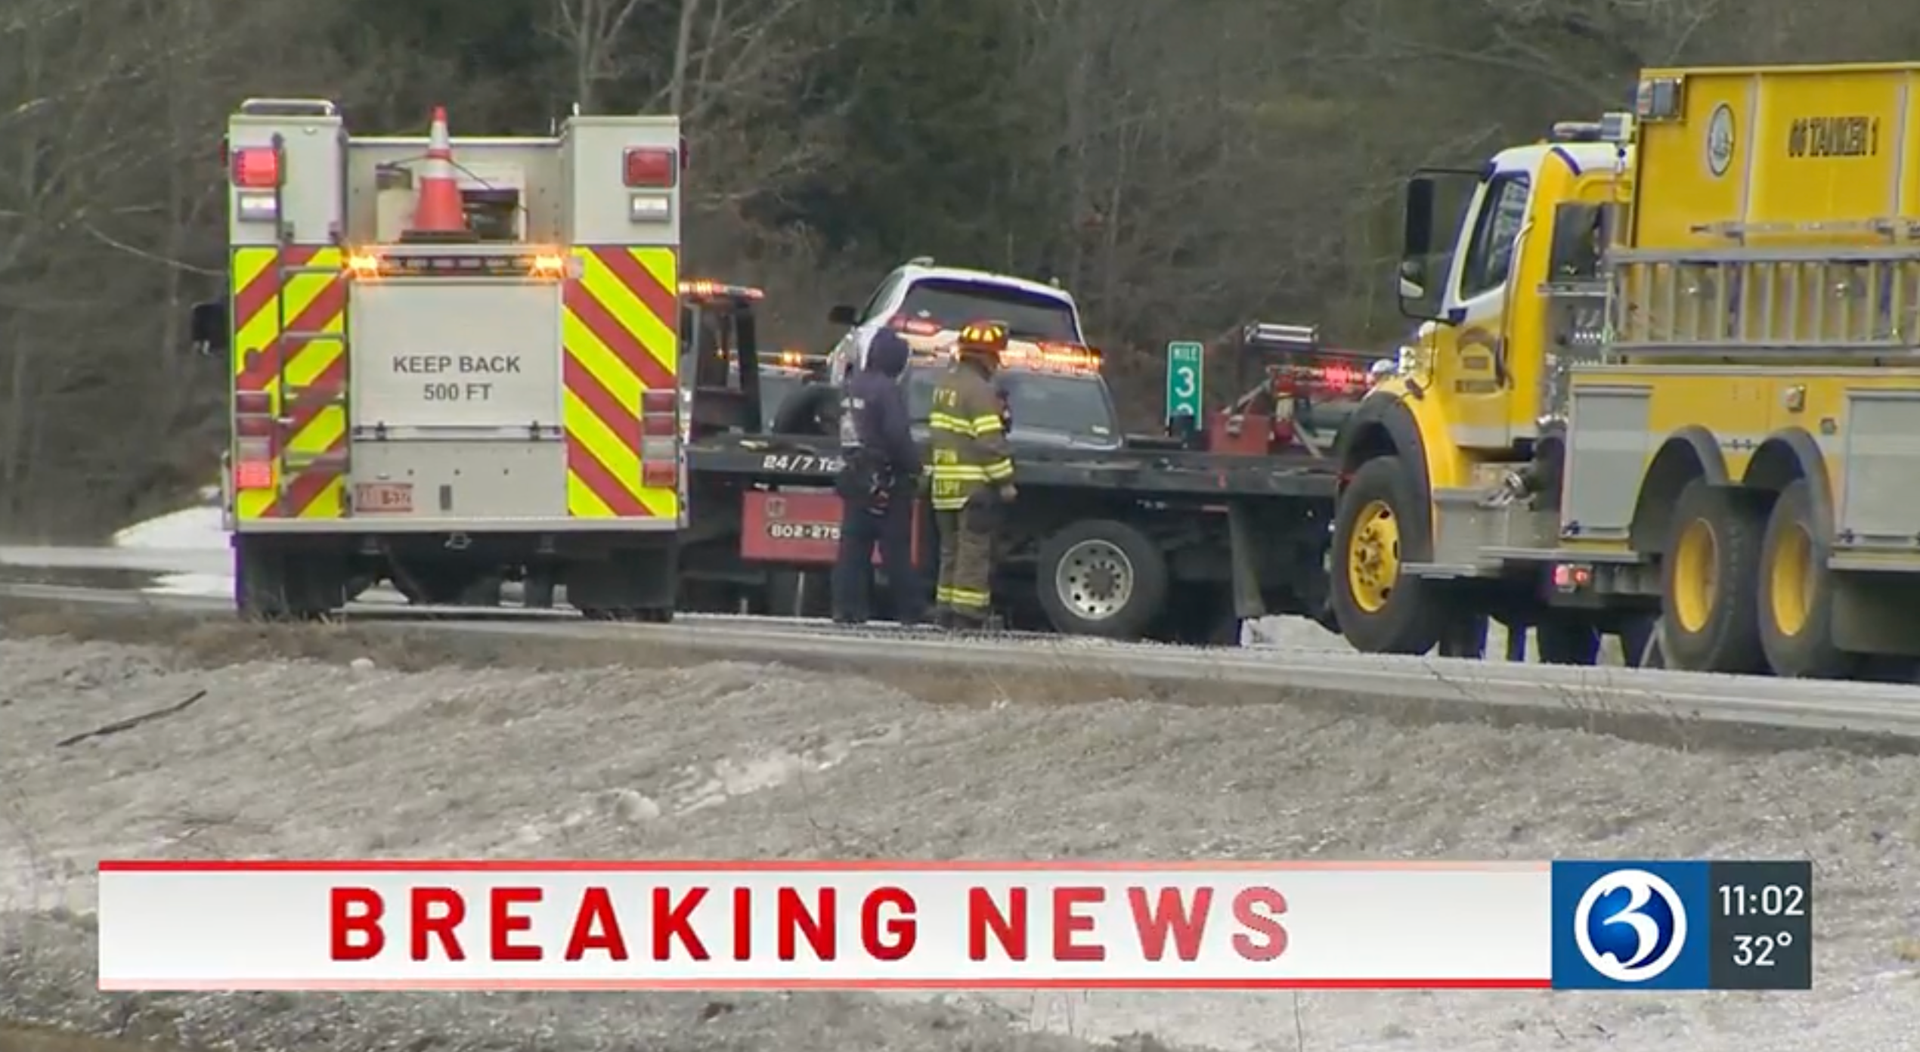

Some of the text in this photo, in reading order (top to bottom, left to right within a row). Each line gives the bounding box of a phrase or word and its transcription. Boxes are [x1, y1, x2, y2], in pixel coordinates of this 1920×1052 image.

[1174, 347, 1198, 361] MILE
[393, 356, 521, 373] KEEP BACK
[424, 383, 491, 400] 500 FT
[763, 454, 814, 471] 24/7
